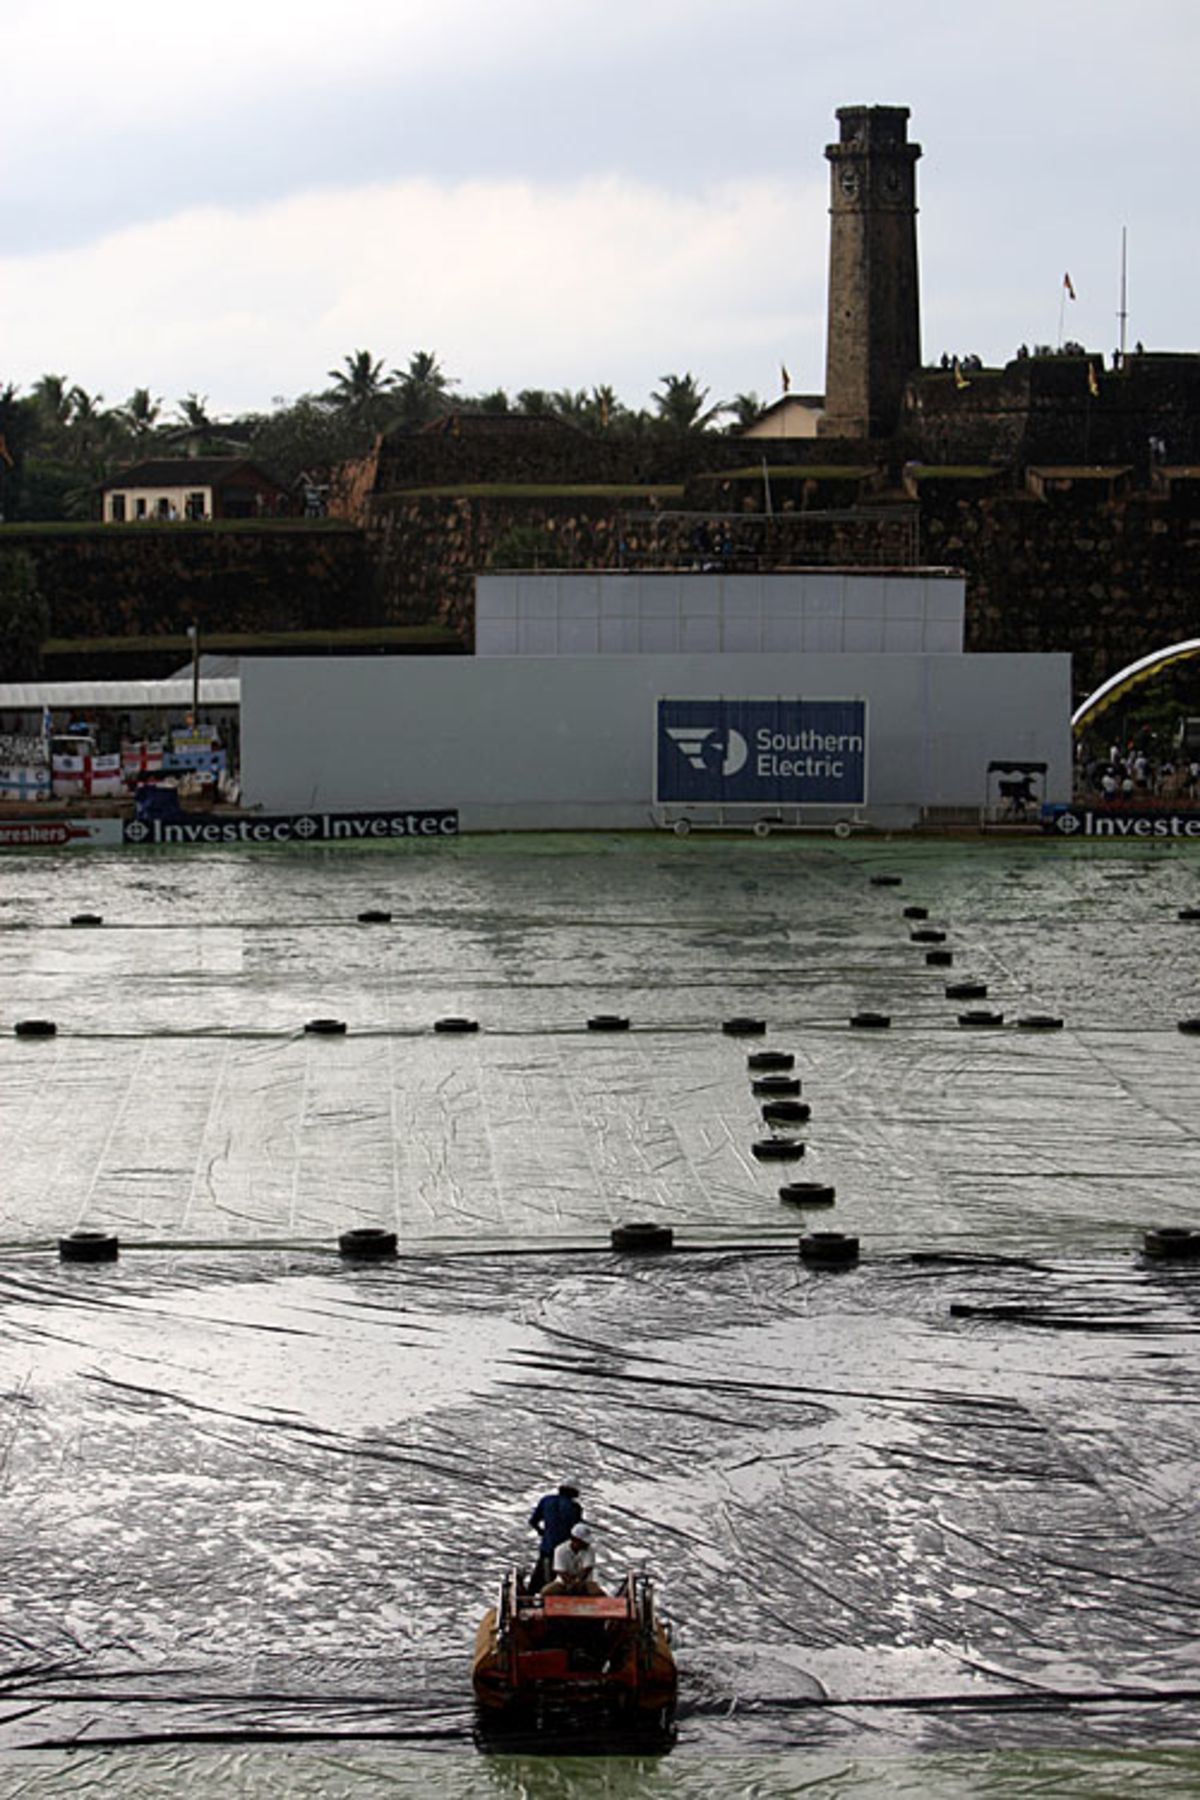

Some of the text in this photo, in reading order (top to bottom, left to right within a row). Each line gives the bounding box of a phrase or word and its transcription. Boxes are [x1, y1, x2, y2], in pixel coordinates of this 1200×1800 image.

[757, 728, 862, 752] Southern
[757, 754, 844, 778] Electric
[153, 817, 291, 842] Investec
[323, 811, 457, 838] Investec
